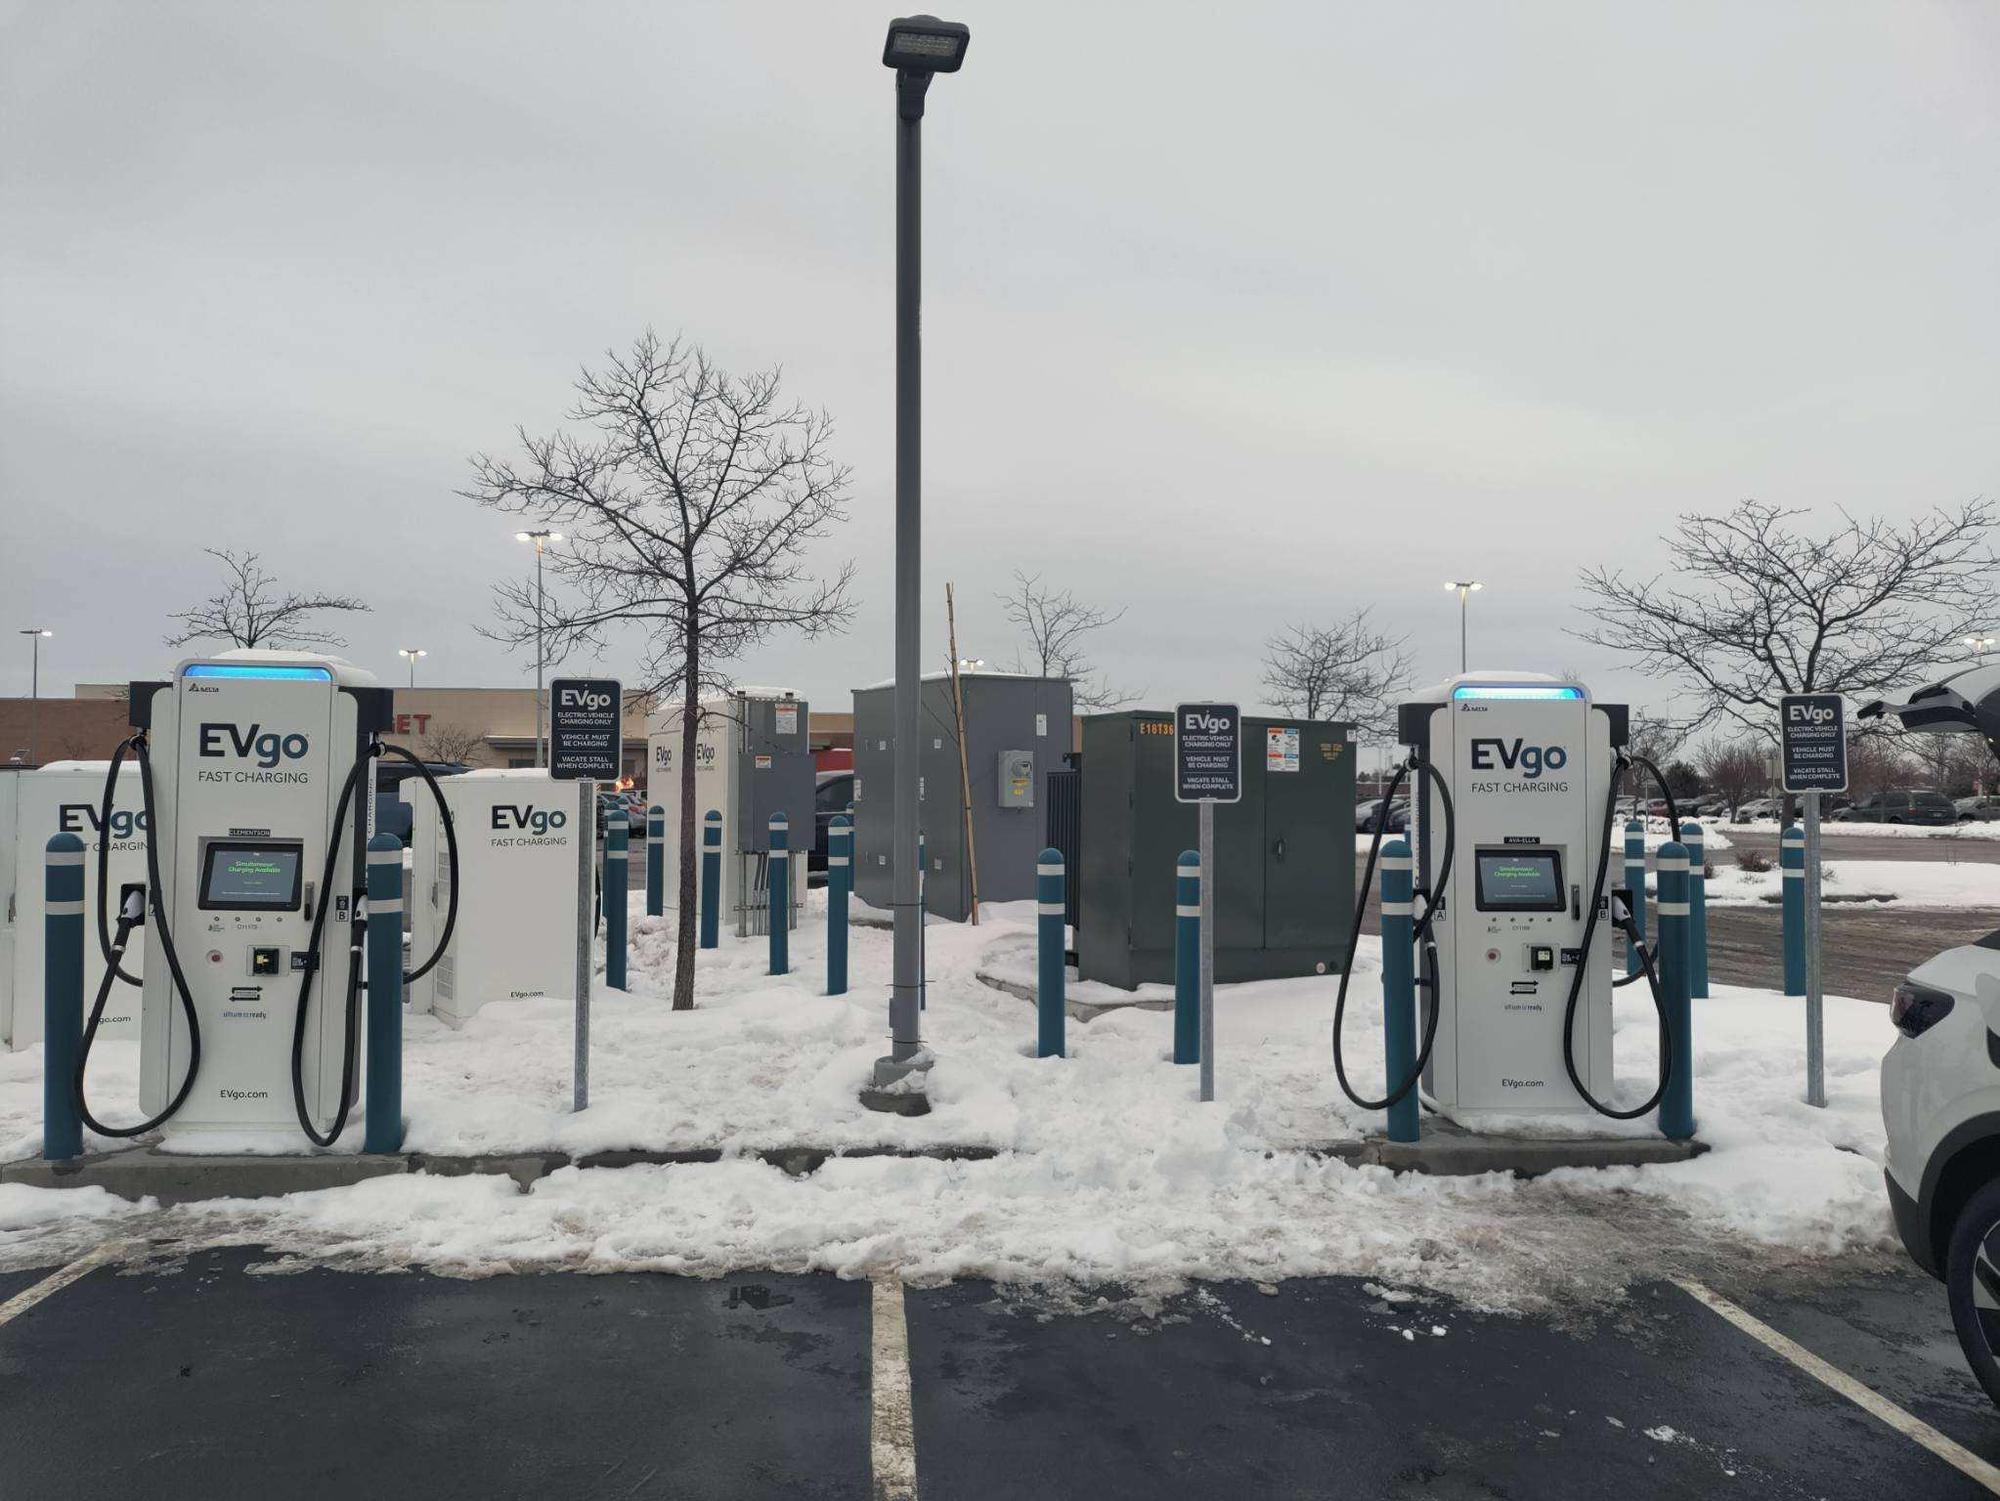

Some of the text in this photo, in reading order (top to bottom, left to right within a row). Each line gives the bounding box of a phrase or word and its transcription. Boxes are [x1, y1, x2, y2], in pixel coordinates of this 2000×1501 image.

[561, 690, 611, 711] EVgo
[1790, 705, 1834, 724] EVgo
[1185, 714, 1230, 734] EVgo
[200, 723, 309, 769] EVgo
[1471, 738, 1567, 779] EVgo
[198, 771, 309, 784] FAST CHARGING
[1471, 782, 1569, 794] FAST CHARGING
[492, 805, 567, 836] EVgo
[491, 837, 567, 847] FAST CHARGING
[510, 991, 544, 999] EVgo.com
[1501, 1079, 1545, 1089] EVgo.com
[220, 1089, 269, 1101] EVgo.com
